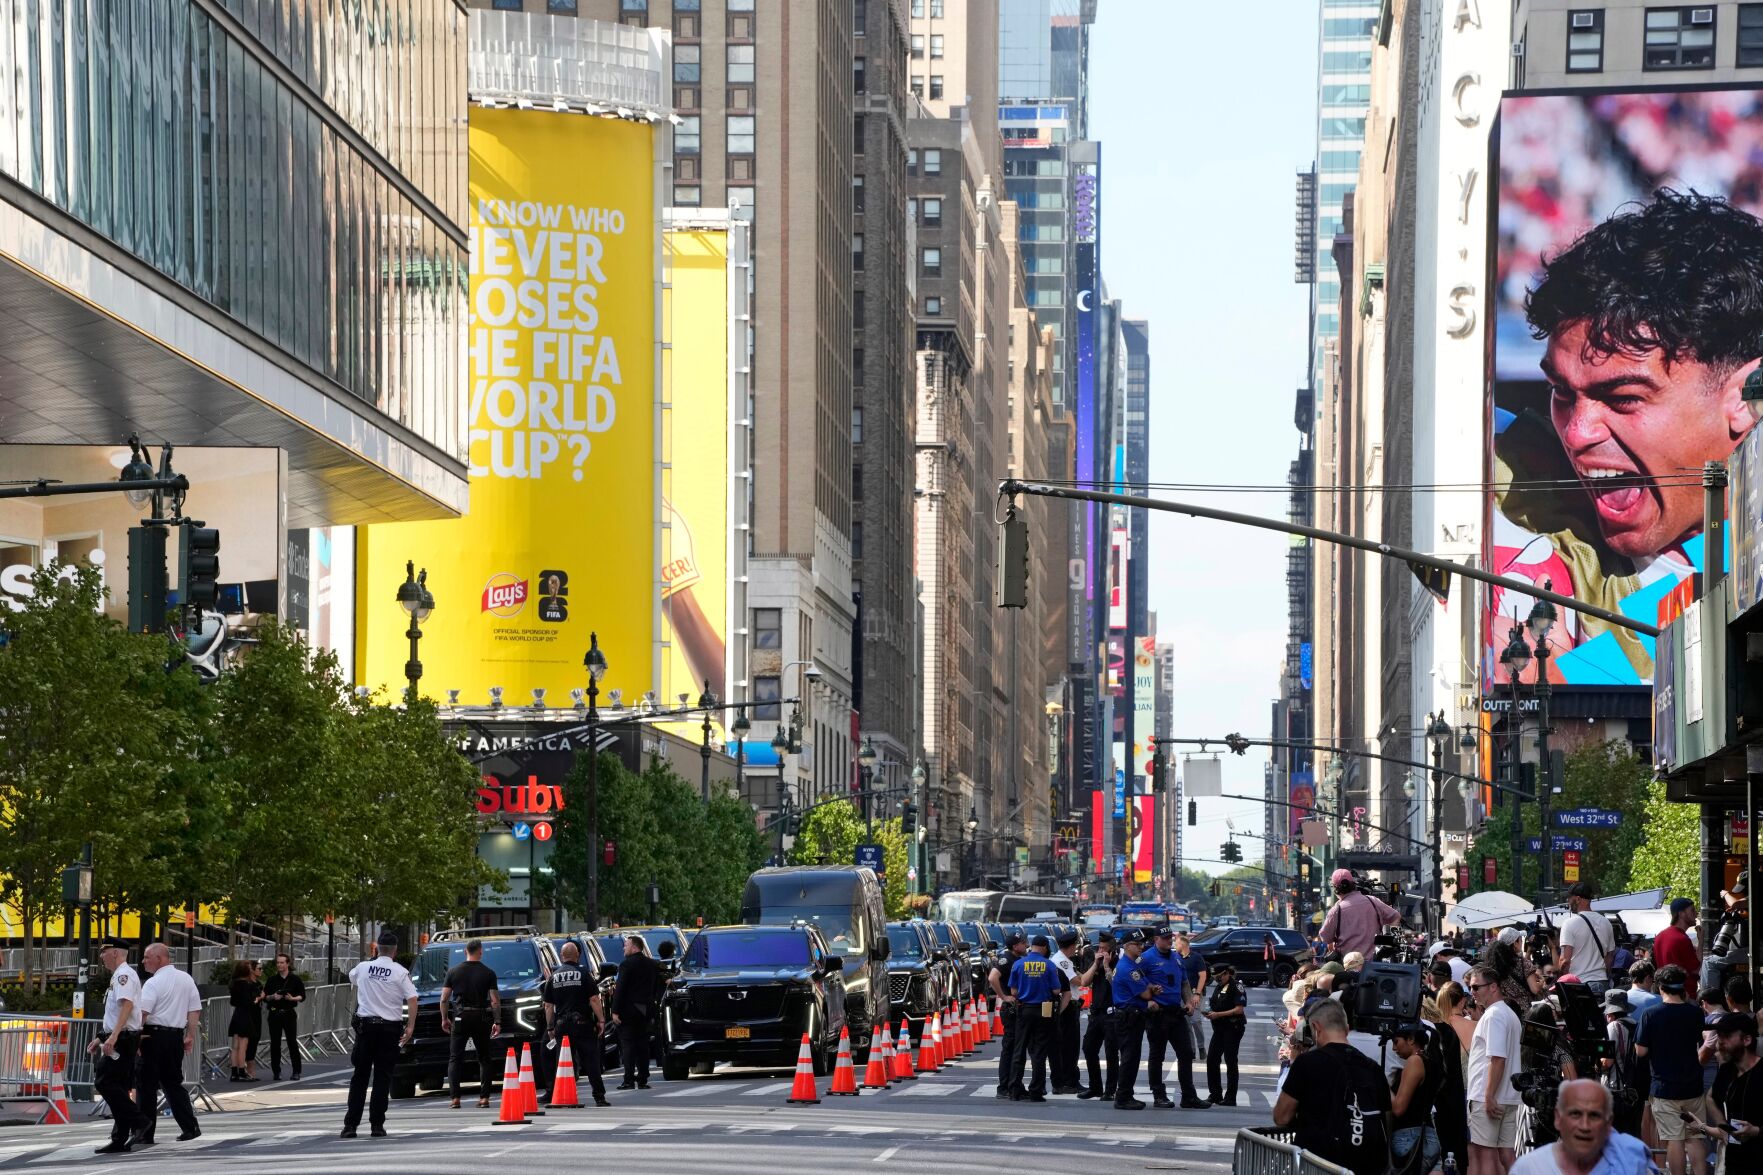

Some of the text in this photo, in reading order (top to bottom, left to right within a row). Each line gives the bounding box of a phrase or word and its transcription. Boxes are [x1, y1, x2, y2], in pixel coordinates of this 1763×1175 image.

[478, 200, 625, 234] KNOW WHO
[469, 278, 598, 332] OSES
[532, 331, 622, 384] FIFA
[1069, 558, 1086, 590] 9
[487, 583, 525, 609] Lay's
[476, 736, 571, 750] AMERICA
[1560, 814, 1618, 824] West 32nd St
[1574, 841, 1583, 850] St
[368, 965, 392, 977] NYPD
[1024, 961, 1046, 972] NYPD
[553, 970, 582, 984] NYPD
